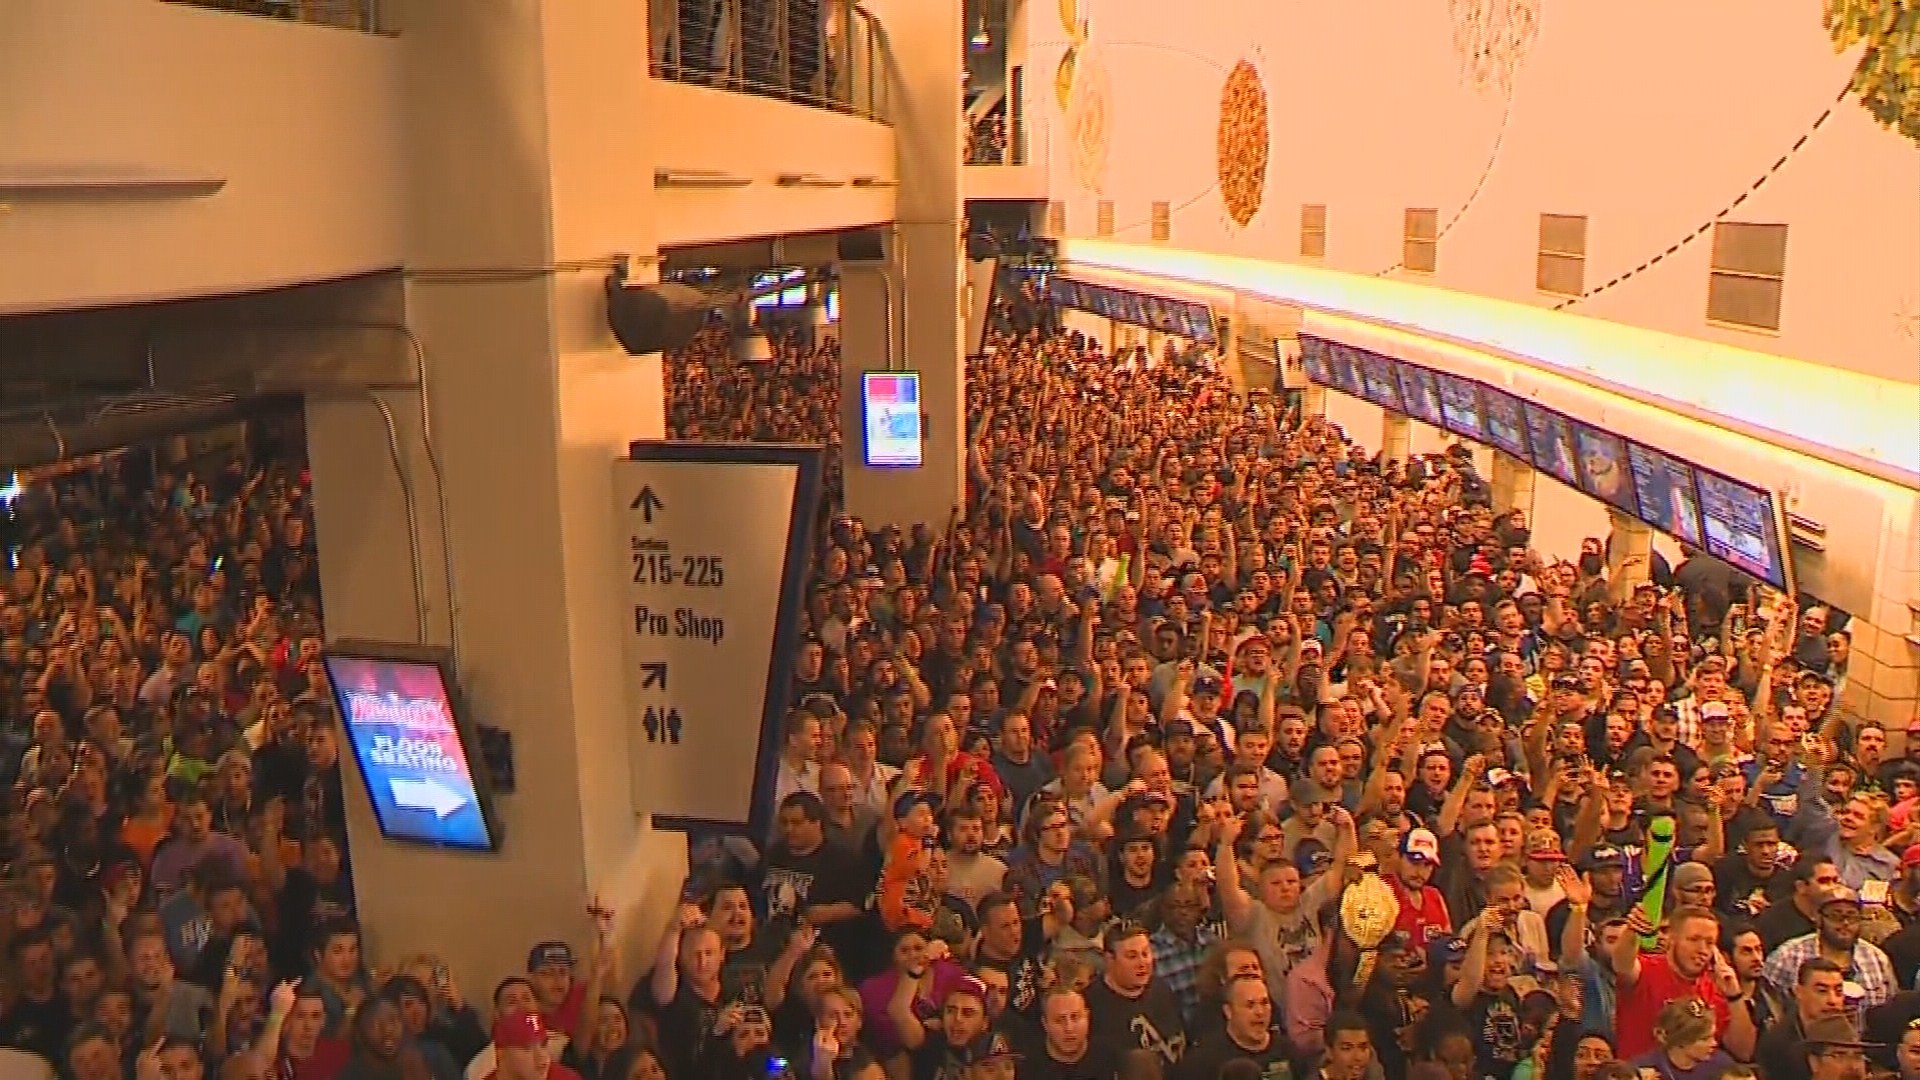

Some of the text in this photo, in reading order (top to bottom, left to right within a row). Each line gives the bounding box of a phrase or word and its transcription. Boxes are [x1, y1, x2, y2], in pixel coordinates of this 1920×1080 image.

[633, 552, 724, 587] 215-225
[635, 604, 724, 645] Pro Shop
[373, 733, 444, 758] FLOOR
